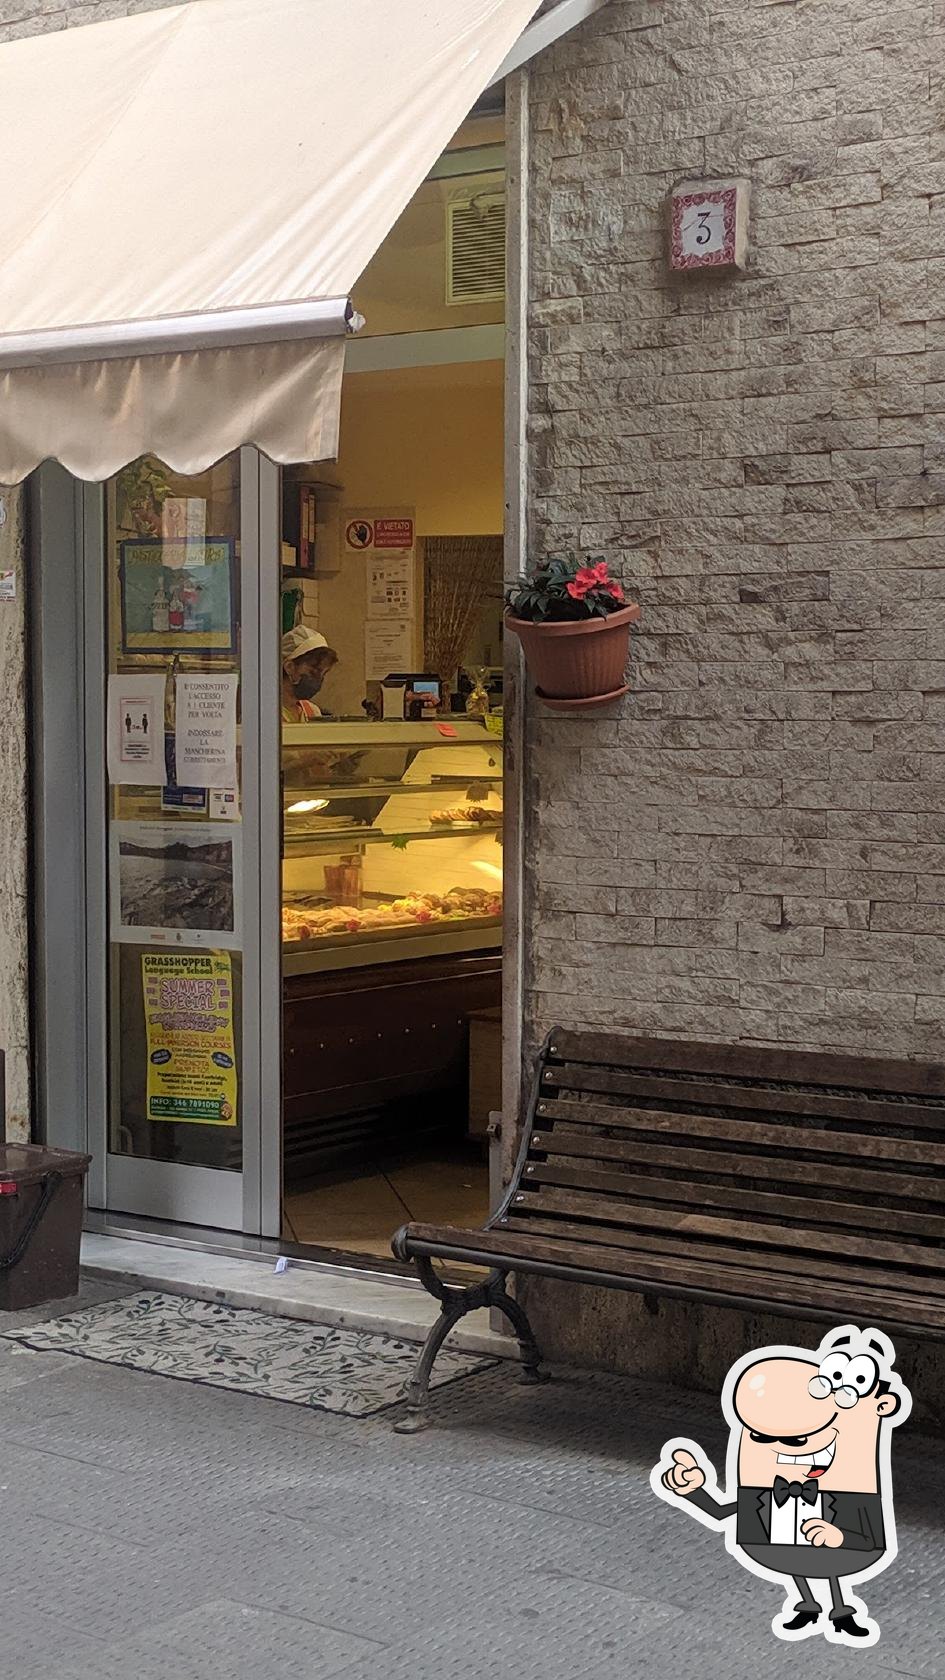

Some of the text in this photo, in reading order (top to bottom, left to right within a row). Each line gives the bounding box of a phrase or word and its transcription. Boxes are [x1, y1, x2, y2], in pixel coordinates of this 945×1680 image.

[696, 211, 711, 244] 3
[144, 957, 212, 967] GRASSHOPPER
[144, 966, 213, 975] Language School
[161, 978, 215, 996] SUMMER
[161, 993, 215, 1010] SPECIAL
